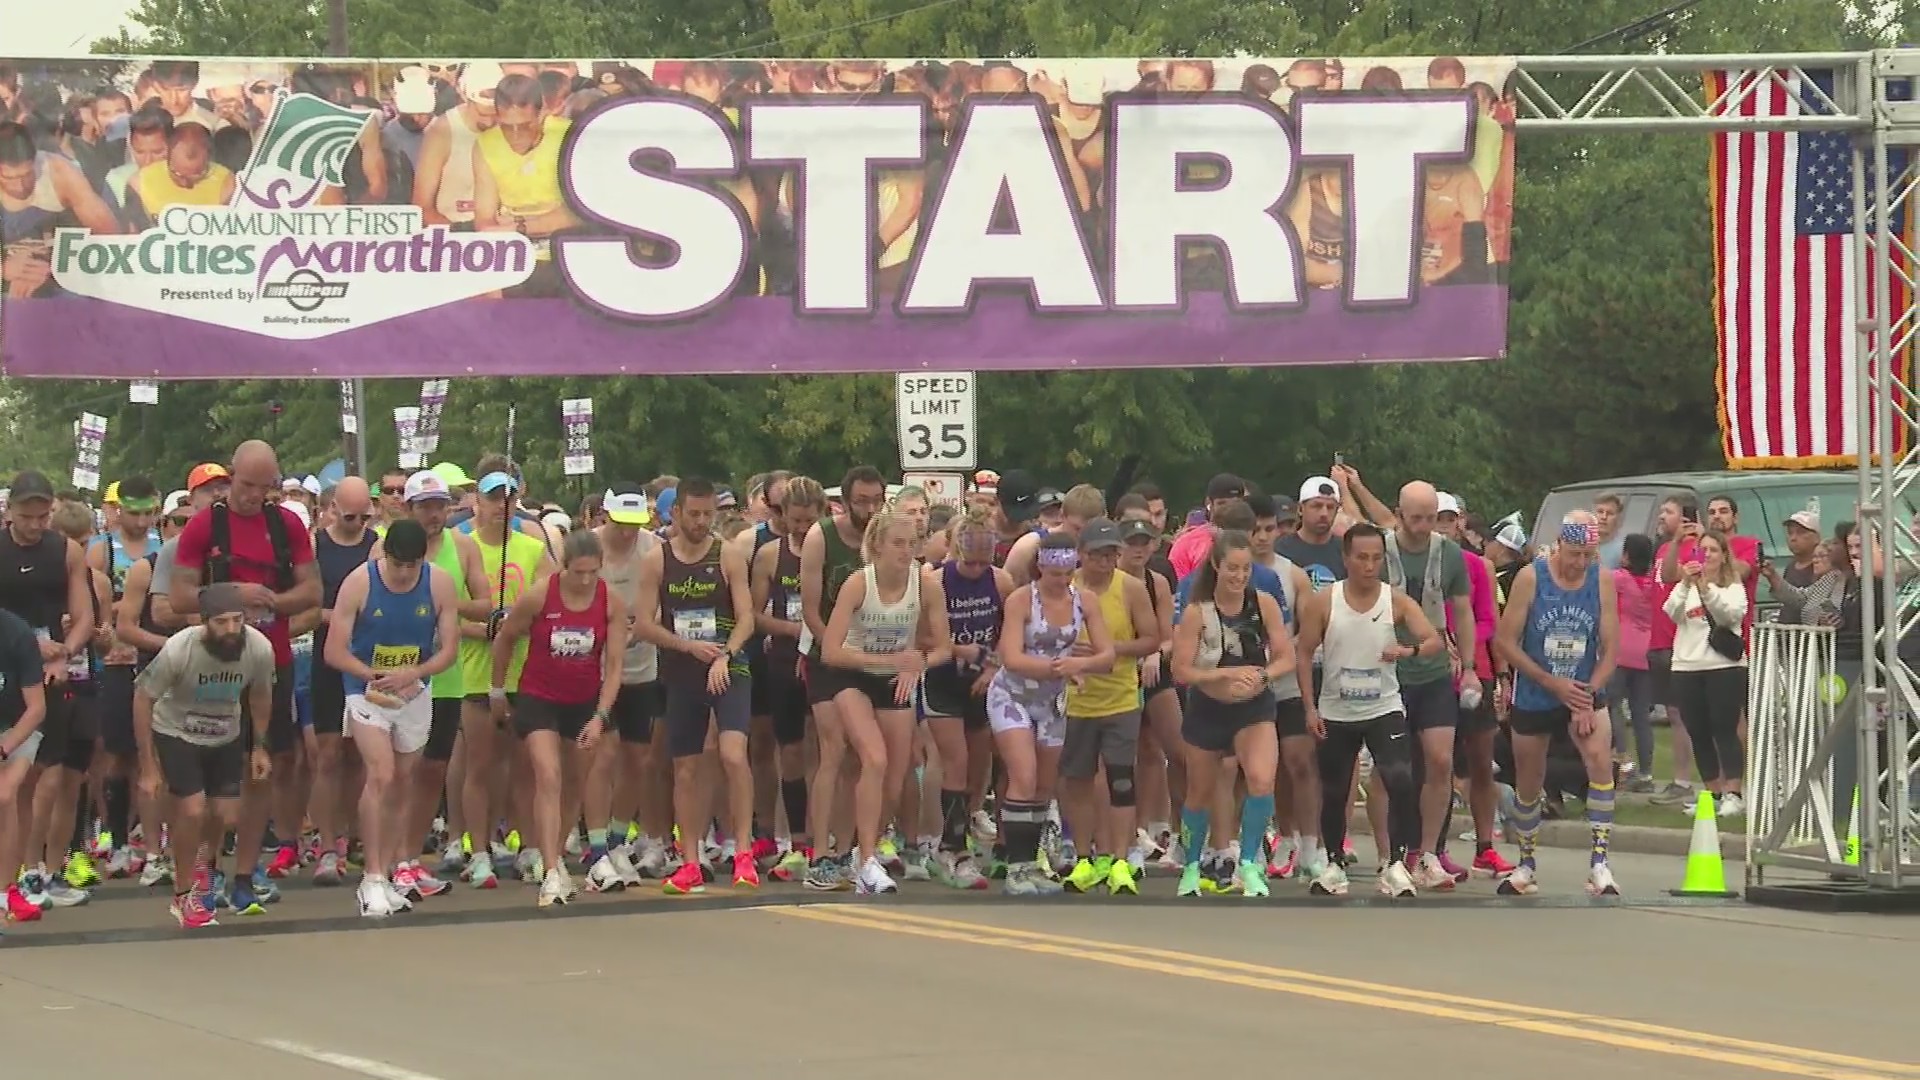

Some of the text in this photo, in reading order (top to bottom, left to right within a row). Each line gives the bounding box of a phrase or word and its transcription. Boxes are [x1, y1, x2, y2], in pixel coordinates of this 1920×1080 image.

[561, 97, 1471, 317] START
[164, 207, 418, 236] COMMUNITY FIRST
[257, 228, 527, 300] Marathon
[161, 288, 255, 303] Presented by
[263, 315, 351, 324] Building Excellence
[904, 379, 968, 393] SPEED
[910, 399, 960, 414] LIMIT
[908, 424, 967, 459] 3.5
[955, 596, 991, 608] believe
[375, 653, 417, 668] RELAY
[198, 671, 243, 685] bellin
